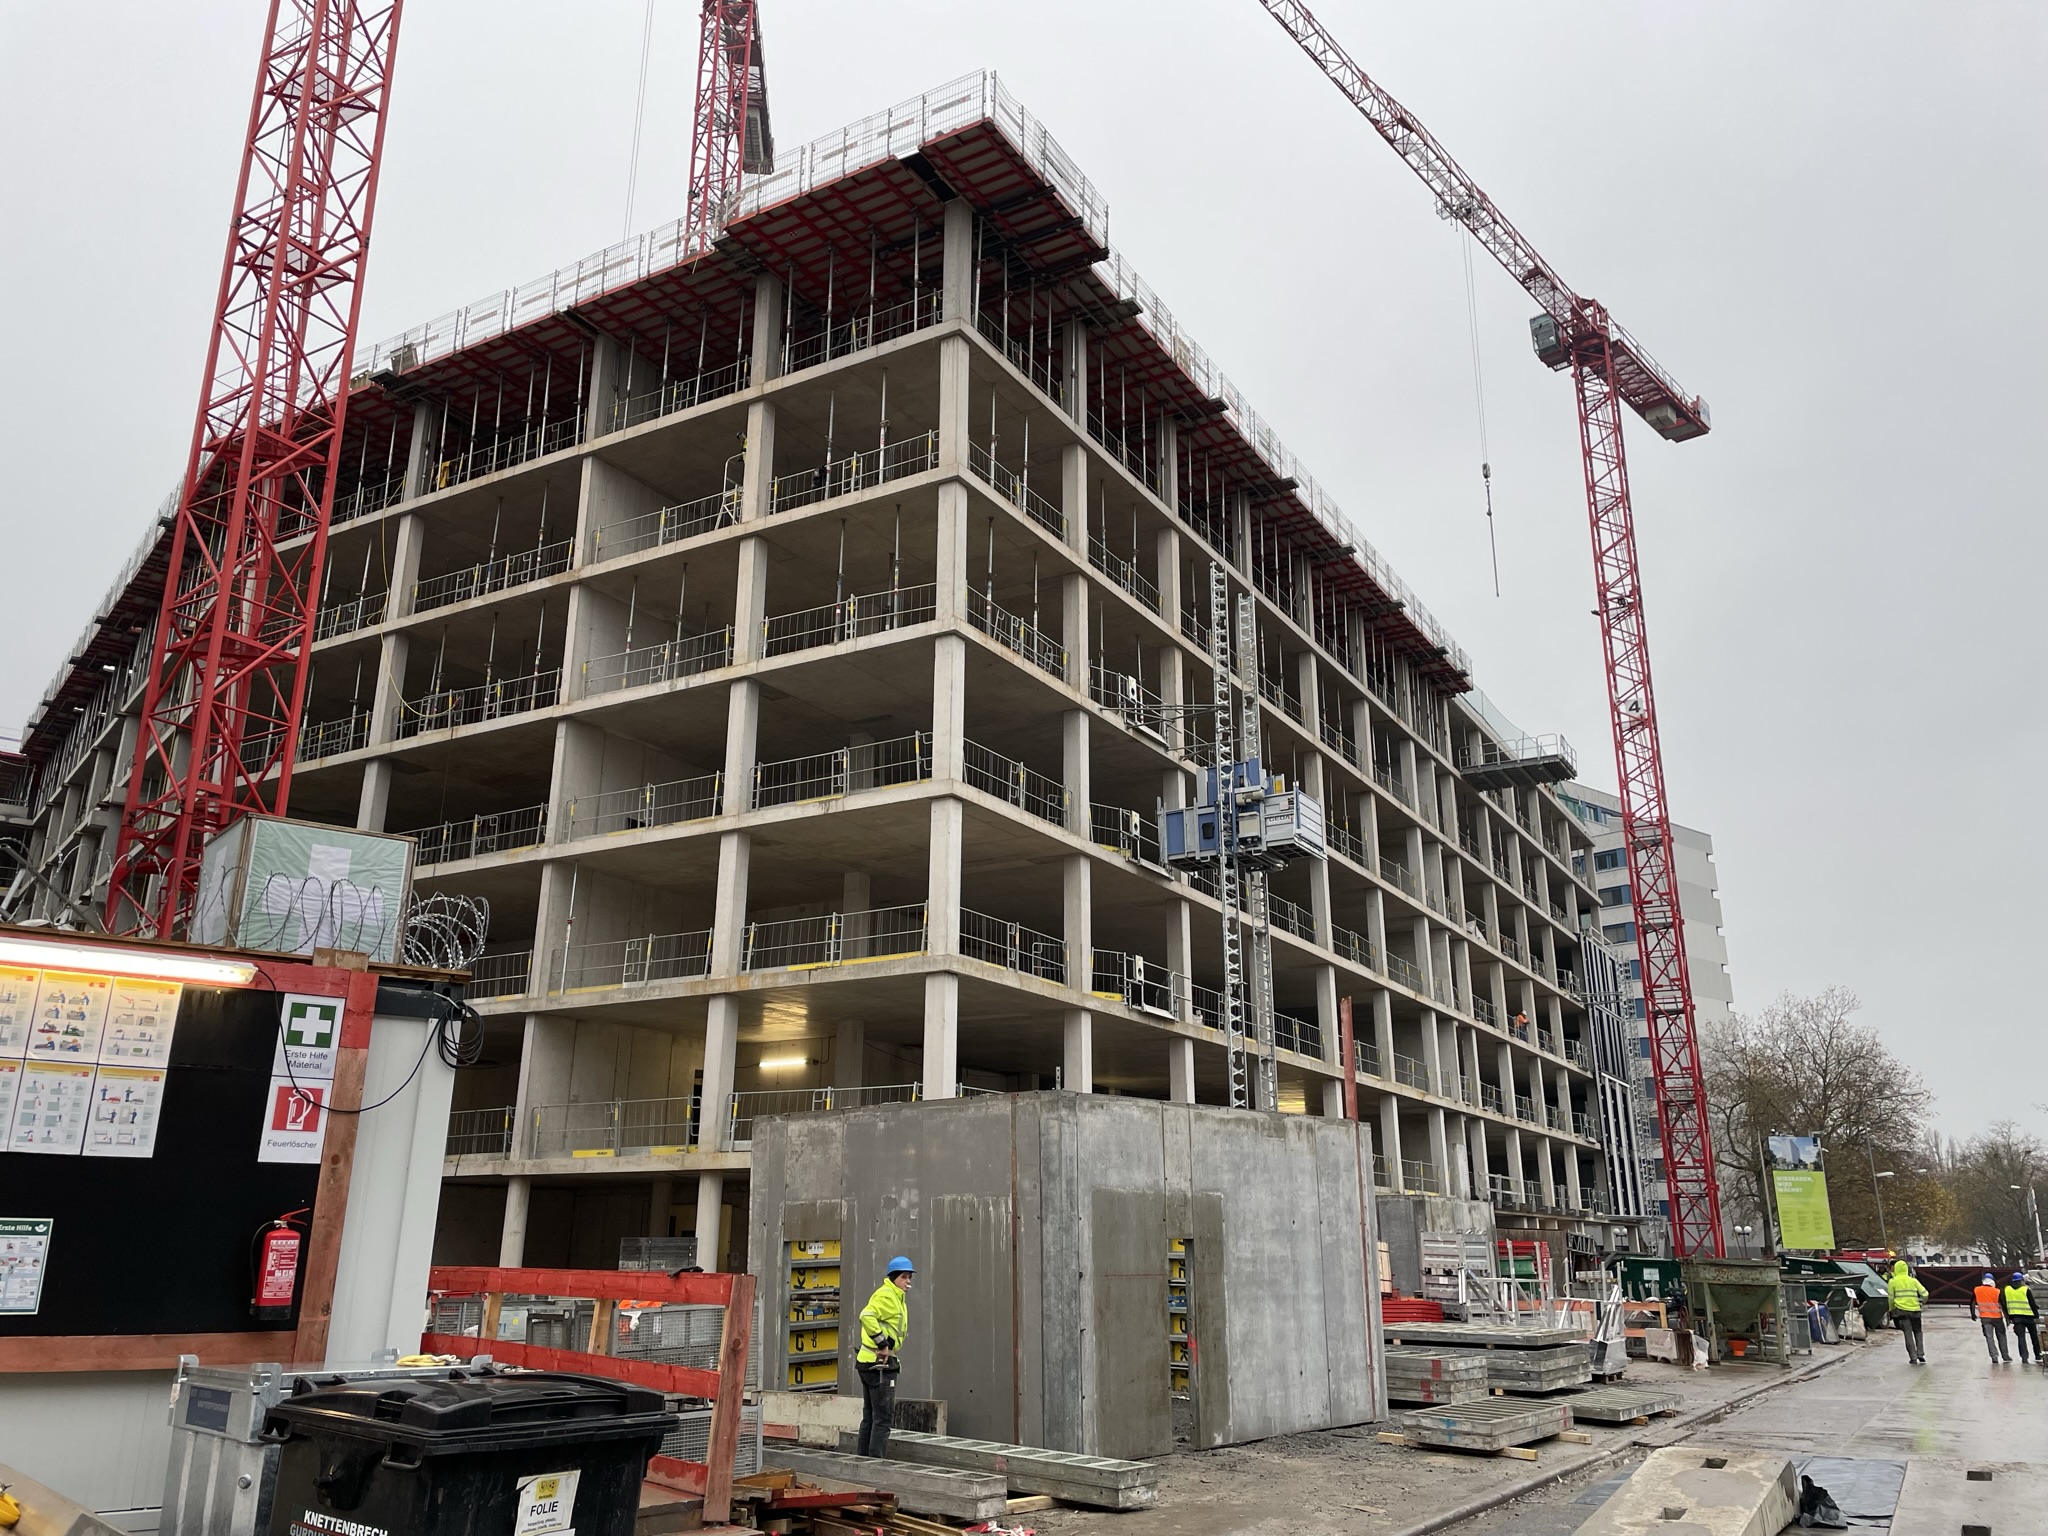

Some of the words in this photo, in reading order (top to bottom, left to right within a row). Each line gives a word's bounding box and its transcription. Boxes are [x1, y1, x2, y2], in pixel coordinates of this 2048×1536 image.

[1629, 700, 1641, 713] 4
[286, 1050, 307, 1059] Erste
[309, 1051, 328, 1060] Hilfe
[288, 1060, 322, 1070] Material
[267, 1139, 317, 1149] Feuerlöscher
[530, 1501, 559, 1517] FOLIE
